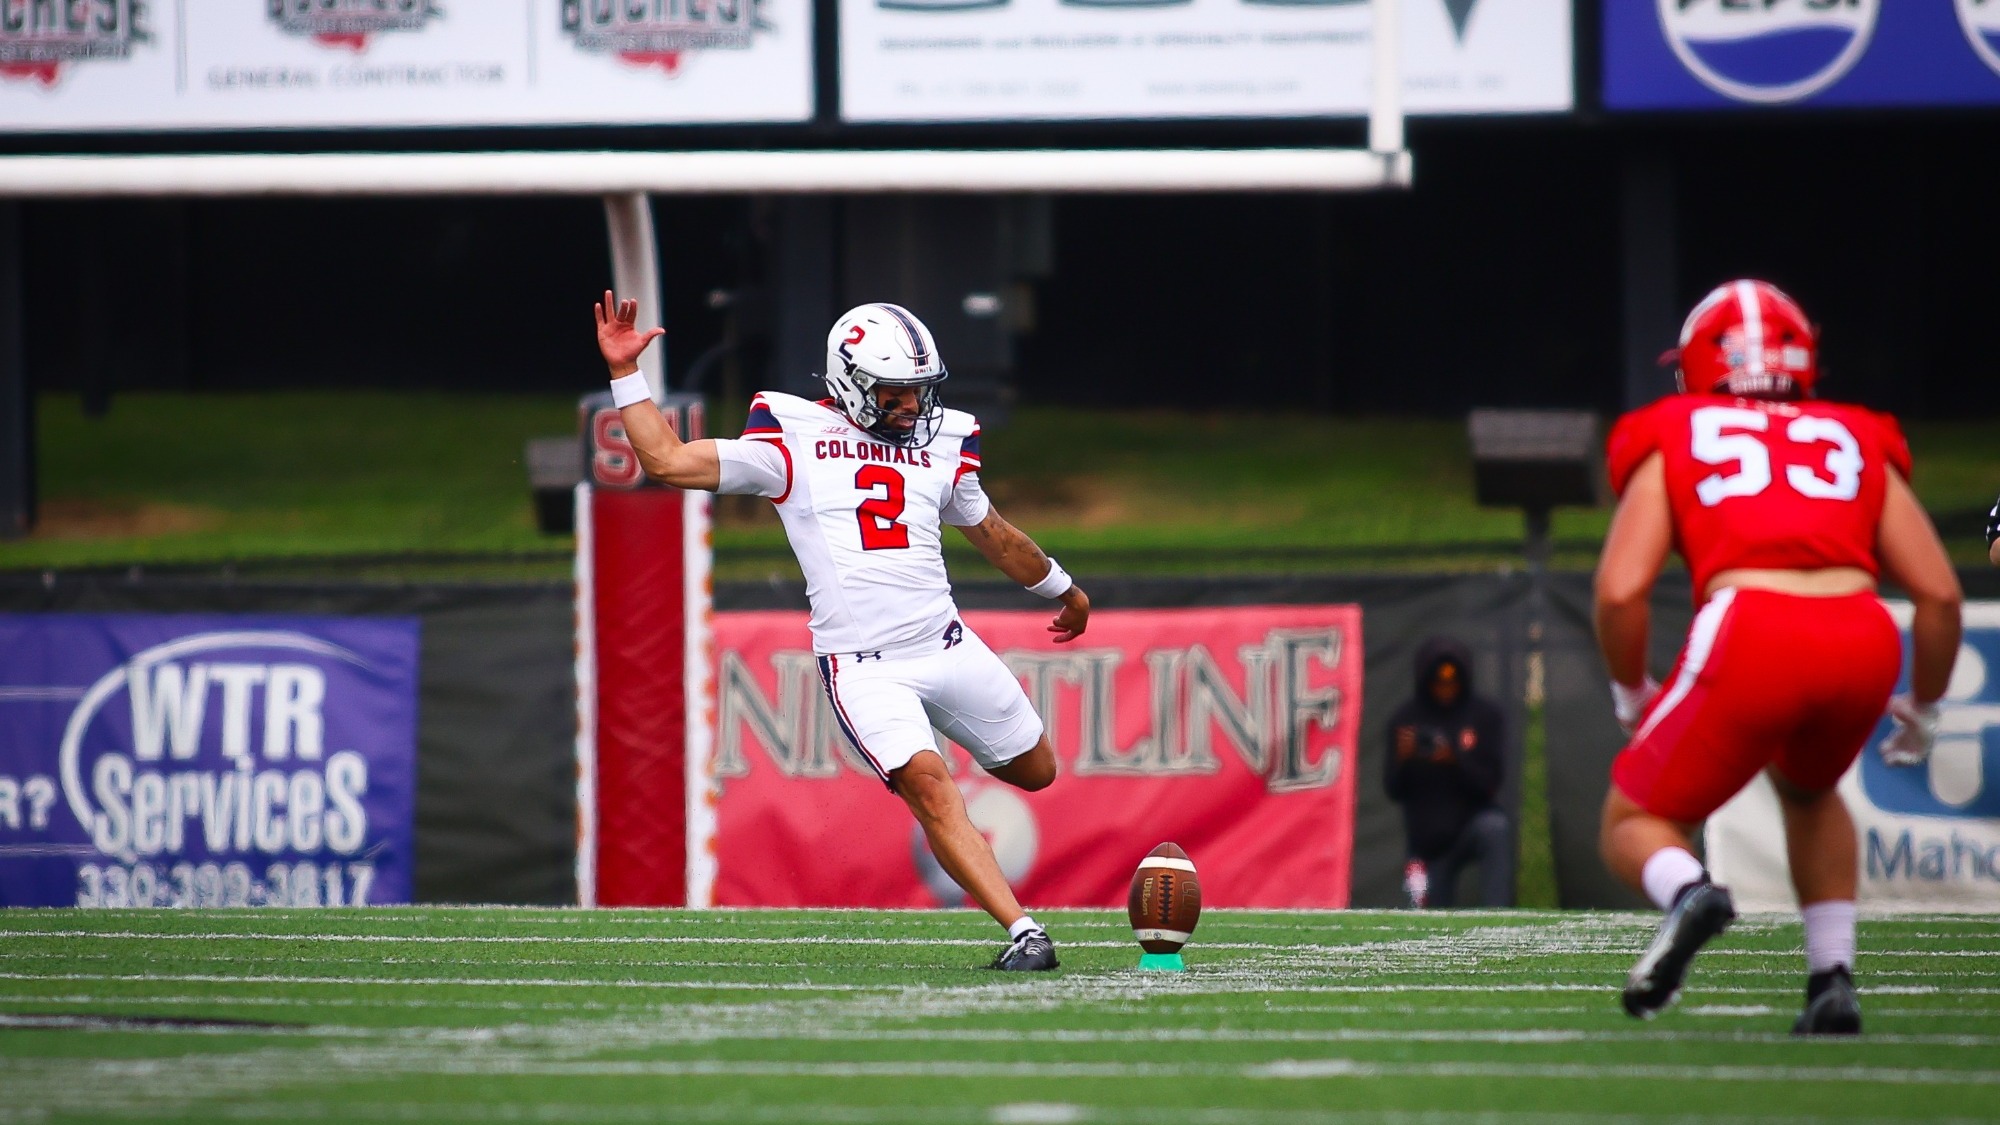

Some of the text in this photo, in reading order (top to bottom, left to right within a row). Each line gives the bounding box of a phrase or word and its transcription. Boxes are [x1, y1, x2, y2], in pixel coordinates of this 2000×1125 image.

[839, 325, 866, 361] 2
[815, 440, 932, 468] COLONIALS
[1690, 406, 1864, 507] 53
[855, 464, 910, 551] 2
[126, 663, 326, 762] WTR
[714, 627, 1341, 793] NITLINE
